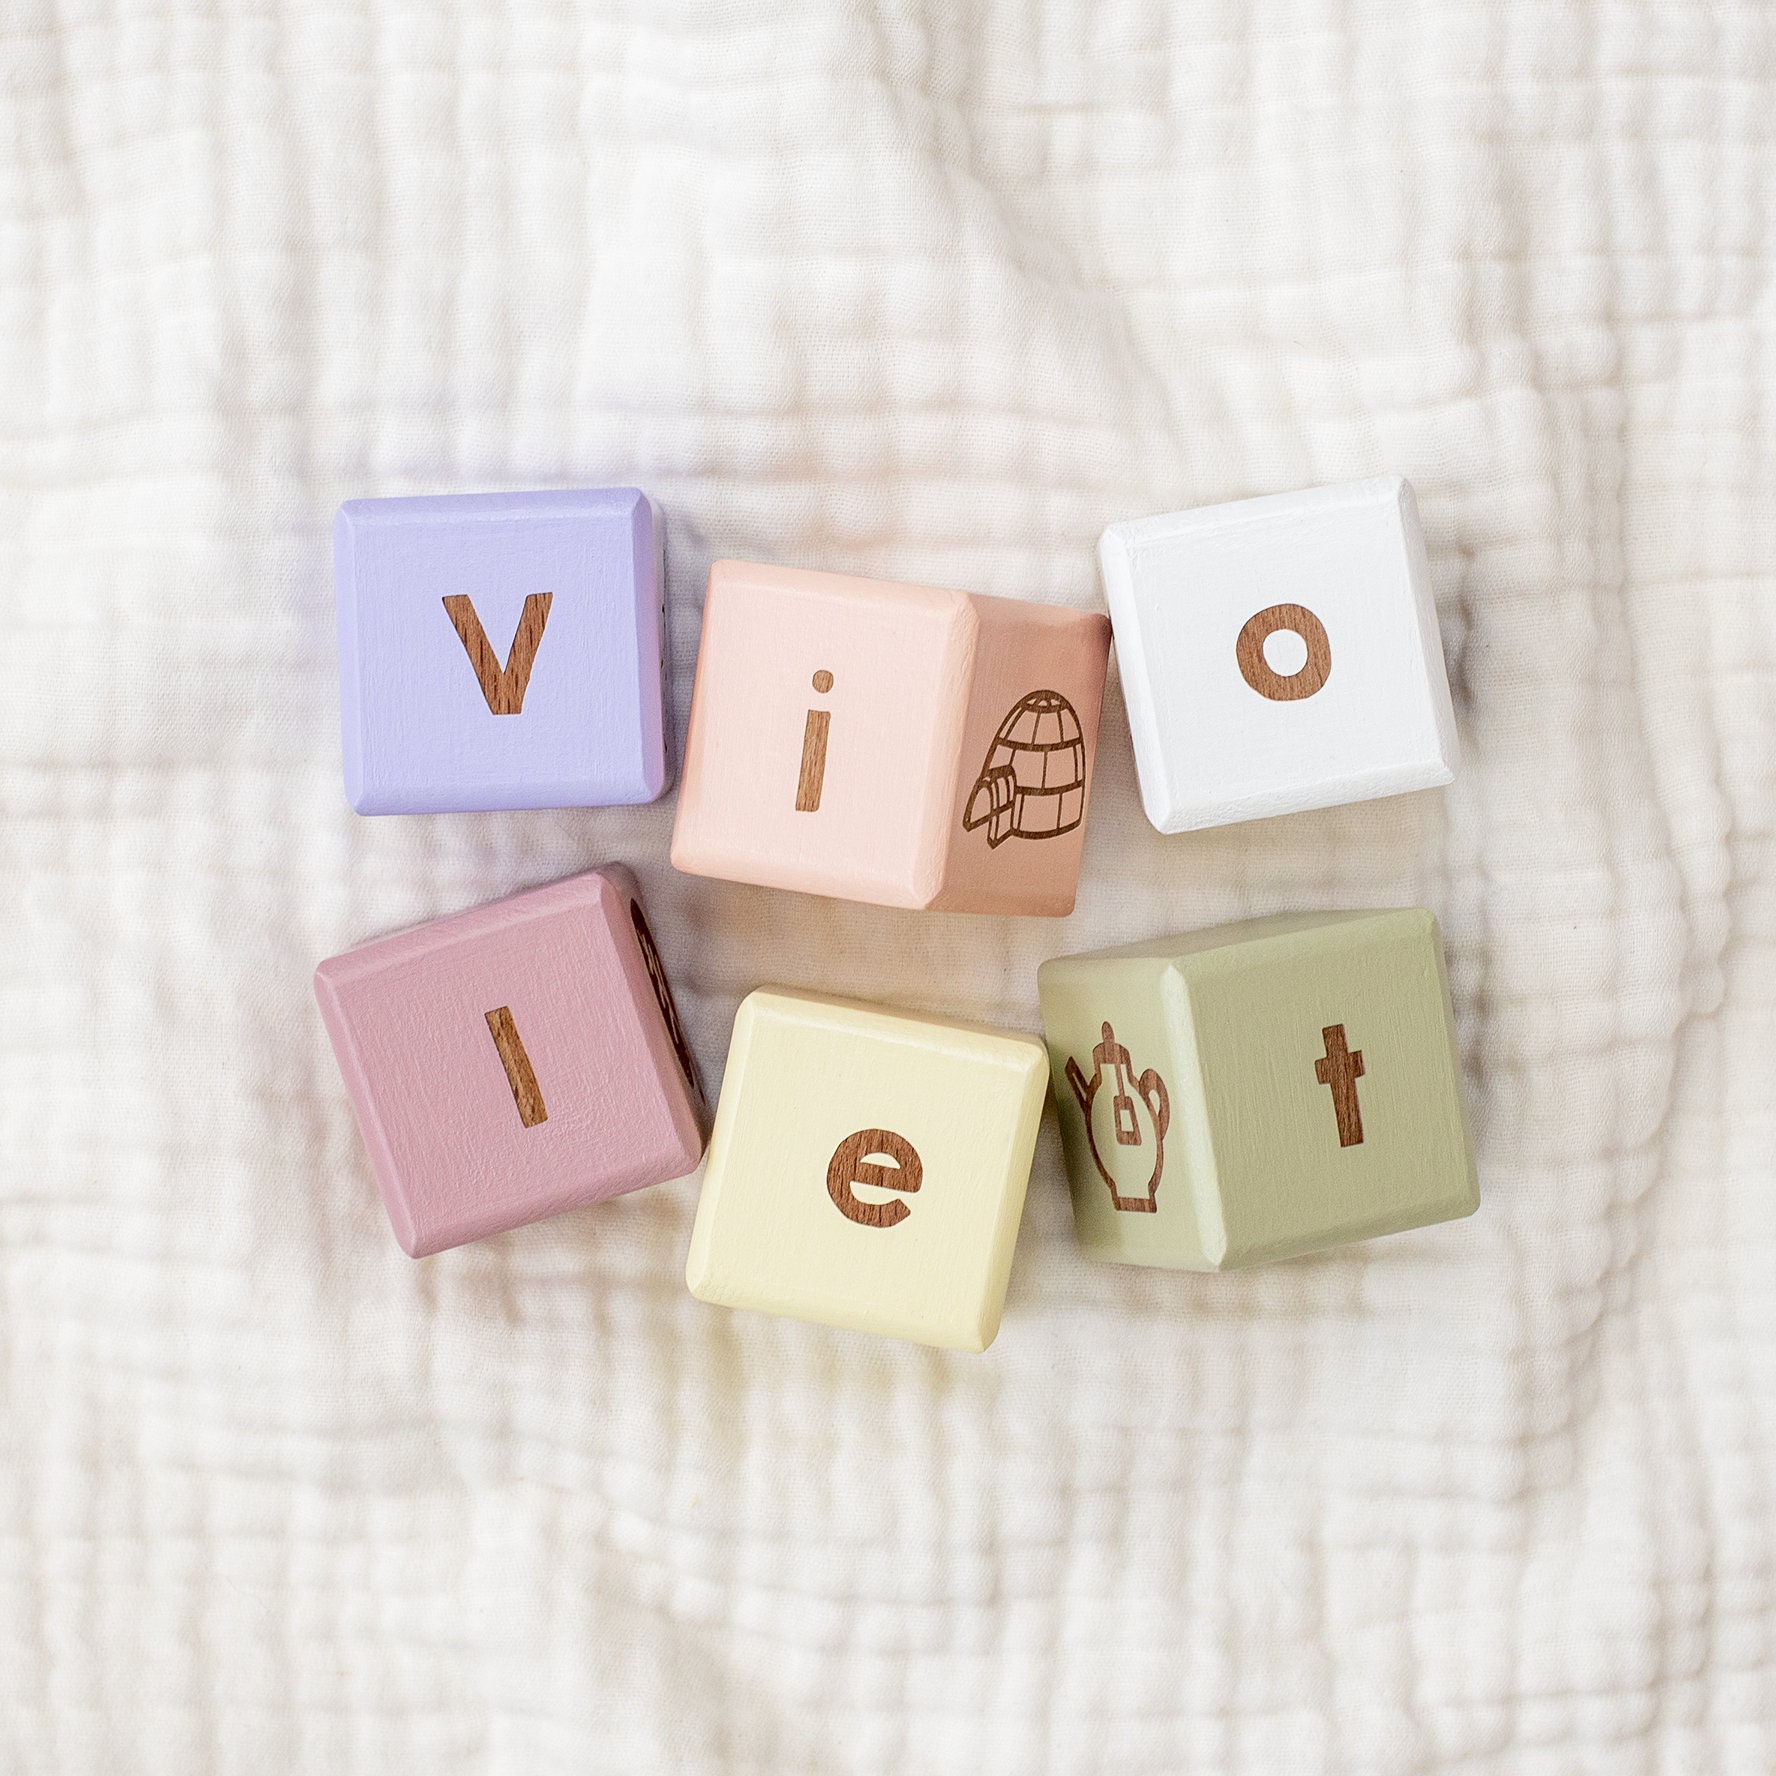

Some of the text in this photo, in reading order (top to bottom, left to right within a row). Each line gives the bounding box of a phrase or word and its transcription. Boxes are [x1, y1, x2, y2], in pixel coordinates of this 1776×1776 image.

[795, 669, 834, 812] i
[1314, 1023, 1367, 1148] t
[827, 1129, 923, 1227] e
